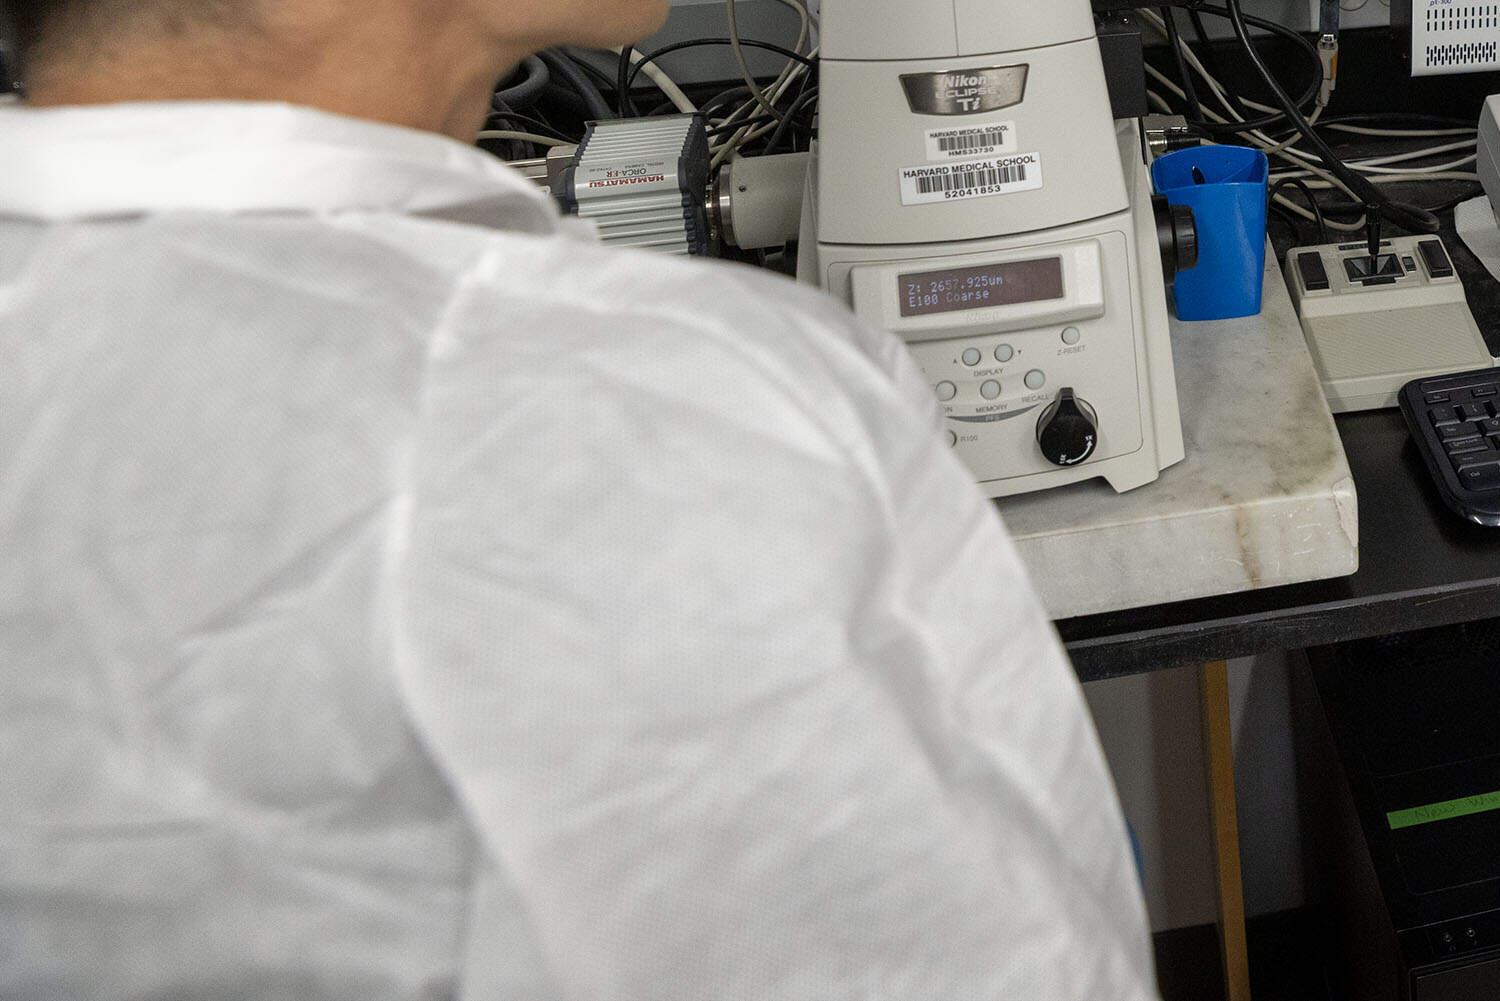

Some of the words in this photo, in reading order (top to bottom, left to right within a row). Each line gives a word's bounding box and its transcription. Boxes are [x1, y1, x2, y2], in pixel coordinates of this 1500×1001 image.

[943, 75, 986, 88] Nikon
[935, 87, 997, 99] ECLIPSE
[956, 97, 981, 111] Ti
[930, 130, 958, 138] HARVARD
[959, 127, 984, 136] MEDICAL
[948, 146, 994, 156] HMS33730
[903, 166, 949, 178] HARVARD
[952, 160, 994, 173] MEDICAL
[996, 155, 1036, 168] SCHOOL
[589, 175, 664, 188] HAMAMATSU
[944, 184, 1001, 199] 52041853
[908, 284, 921, 295] Z:
[946, 290, 989, 303] Coarse
[1056, 345, 1086, 356] Z-RESET
[973, 367, 1004, 377] DISPLAY
[975, 403, 1009, 414] MEMORY
